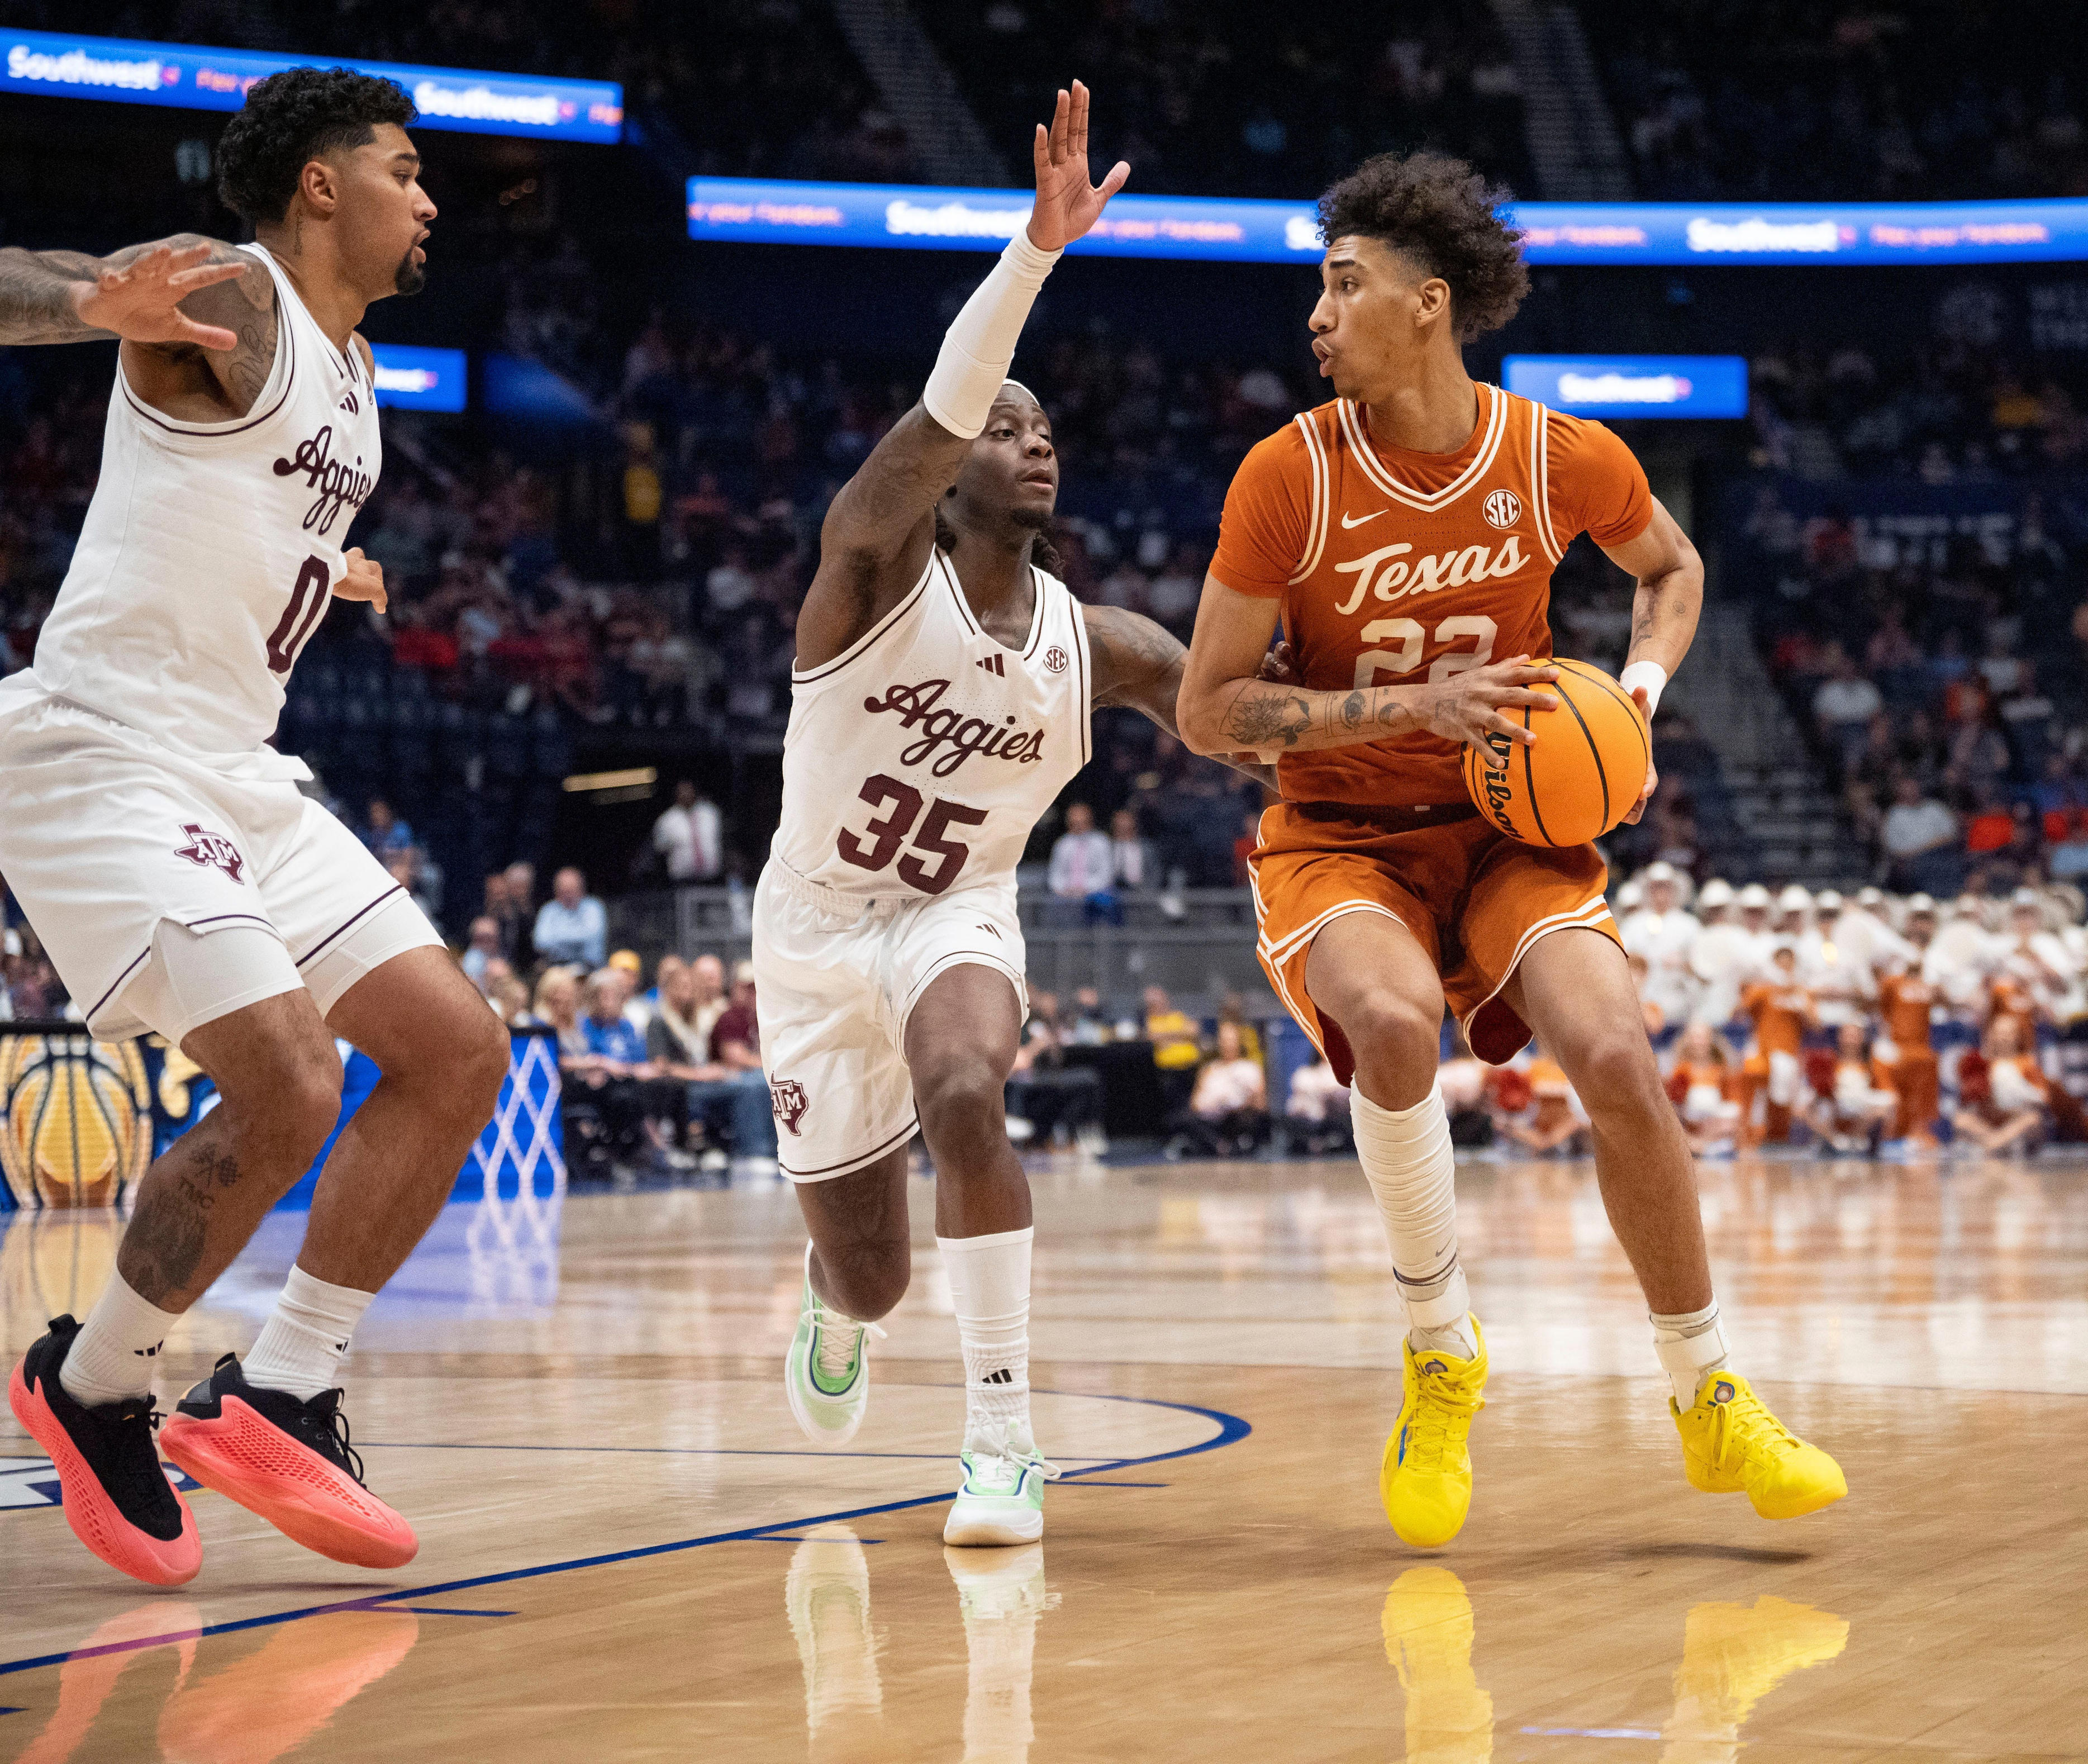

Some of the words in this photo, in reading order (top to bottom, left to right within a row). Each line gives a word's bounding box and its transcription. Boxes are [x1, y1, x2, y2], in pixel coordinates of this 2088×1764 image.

[1486, 492, 1518, 526] SEC
[267, 554, 329, 673] 0
[1335, 536, 1530, 615] Texas
[1046, 649, 1064, 669] SEC
[1353, 615, 1498, 690] 22
[864, 679, 1045, 777] Aggies
[836, 773, 989, 895] 35
